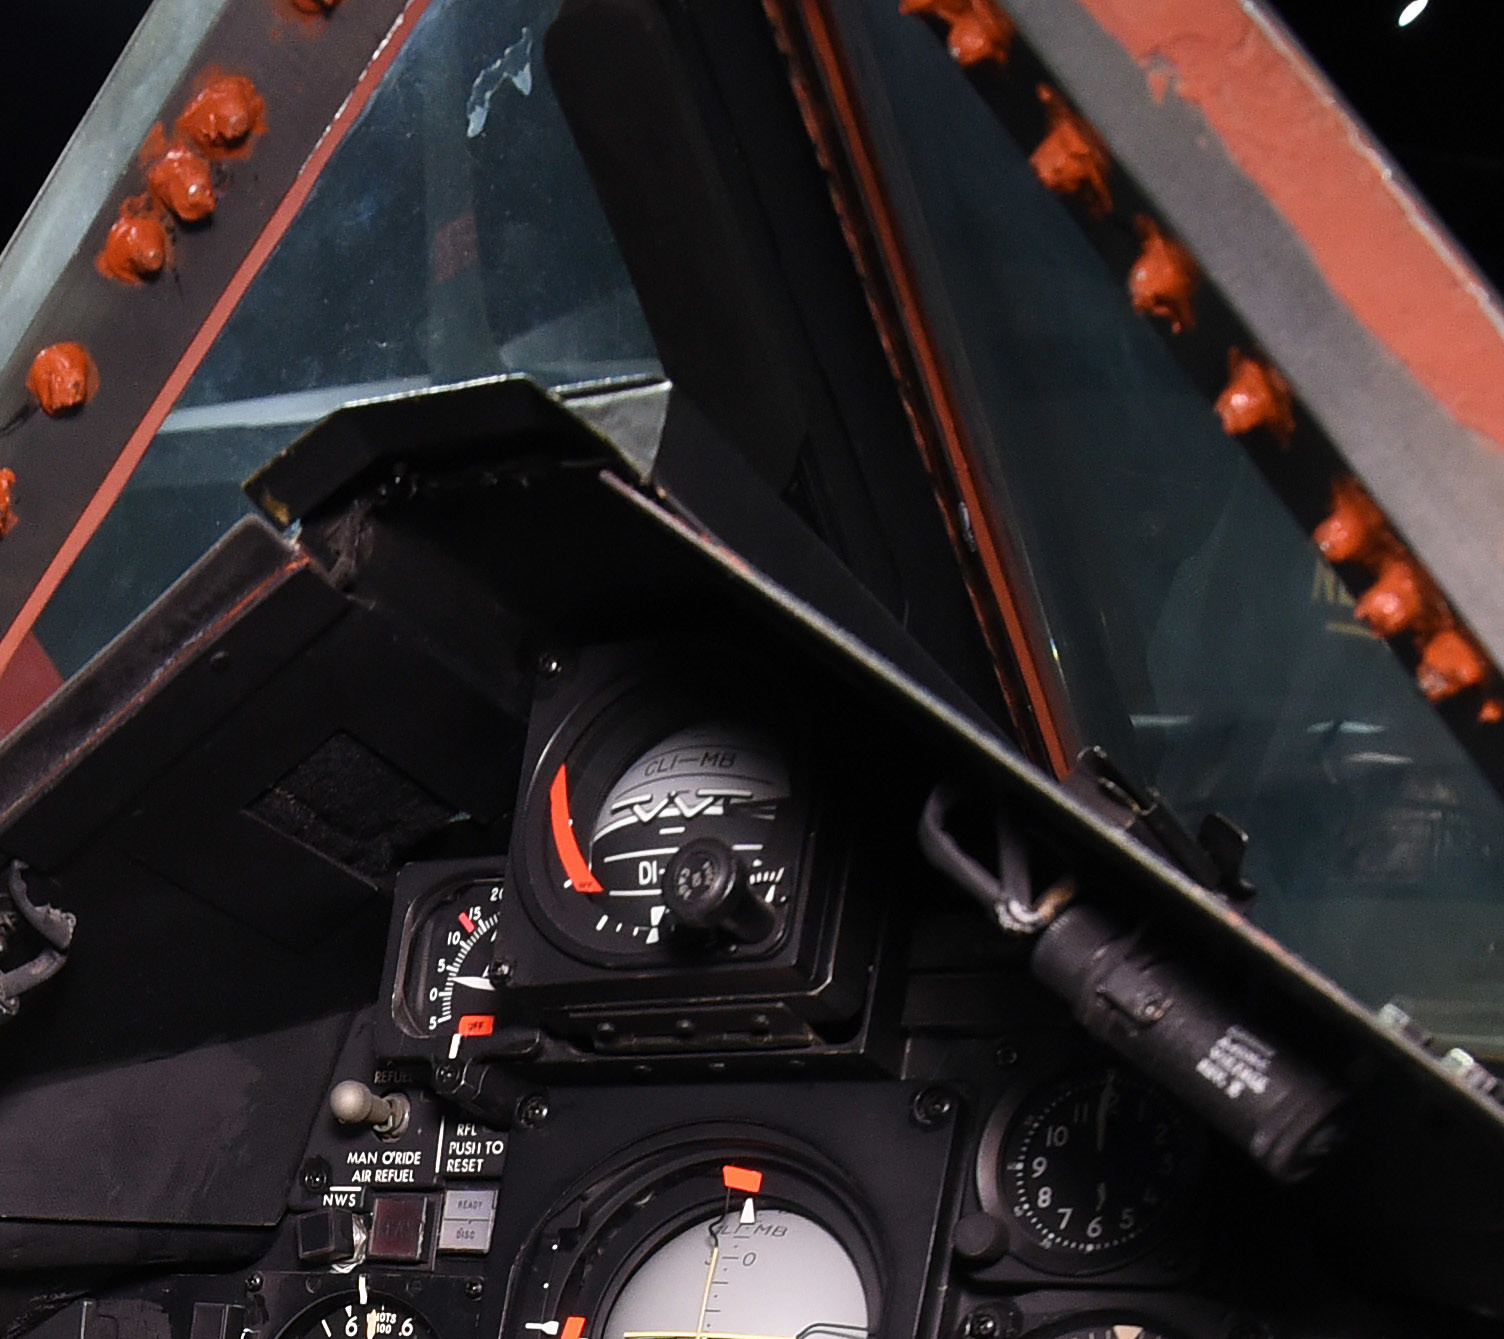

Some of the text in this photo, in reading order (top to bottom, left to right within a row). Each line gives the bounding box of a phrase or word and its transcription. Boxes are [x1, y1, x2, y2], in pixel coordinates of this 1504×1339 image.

[457, 1125, 477, 1136] RFL
[449, 1141, 503, 1155] PUSH TO
[347, 1152, 377, 1164] MAN
[447, 1159, 484, 1172] RESET
[352, 1169, 414, 1182] AIR REFUEL
[323, 1194, 355, 1207] NWS
